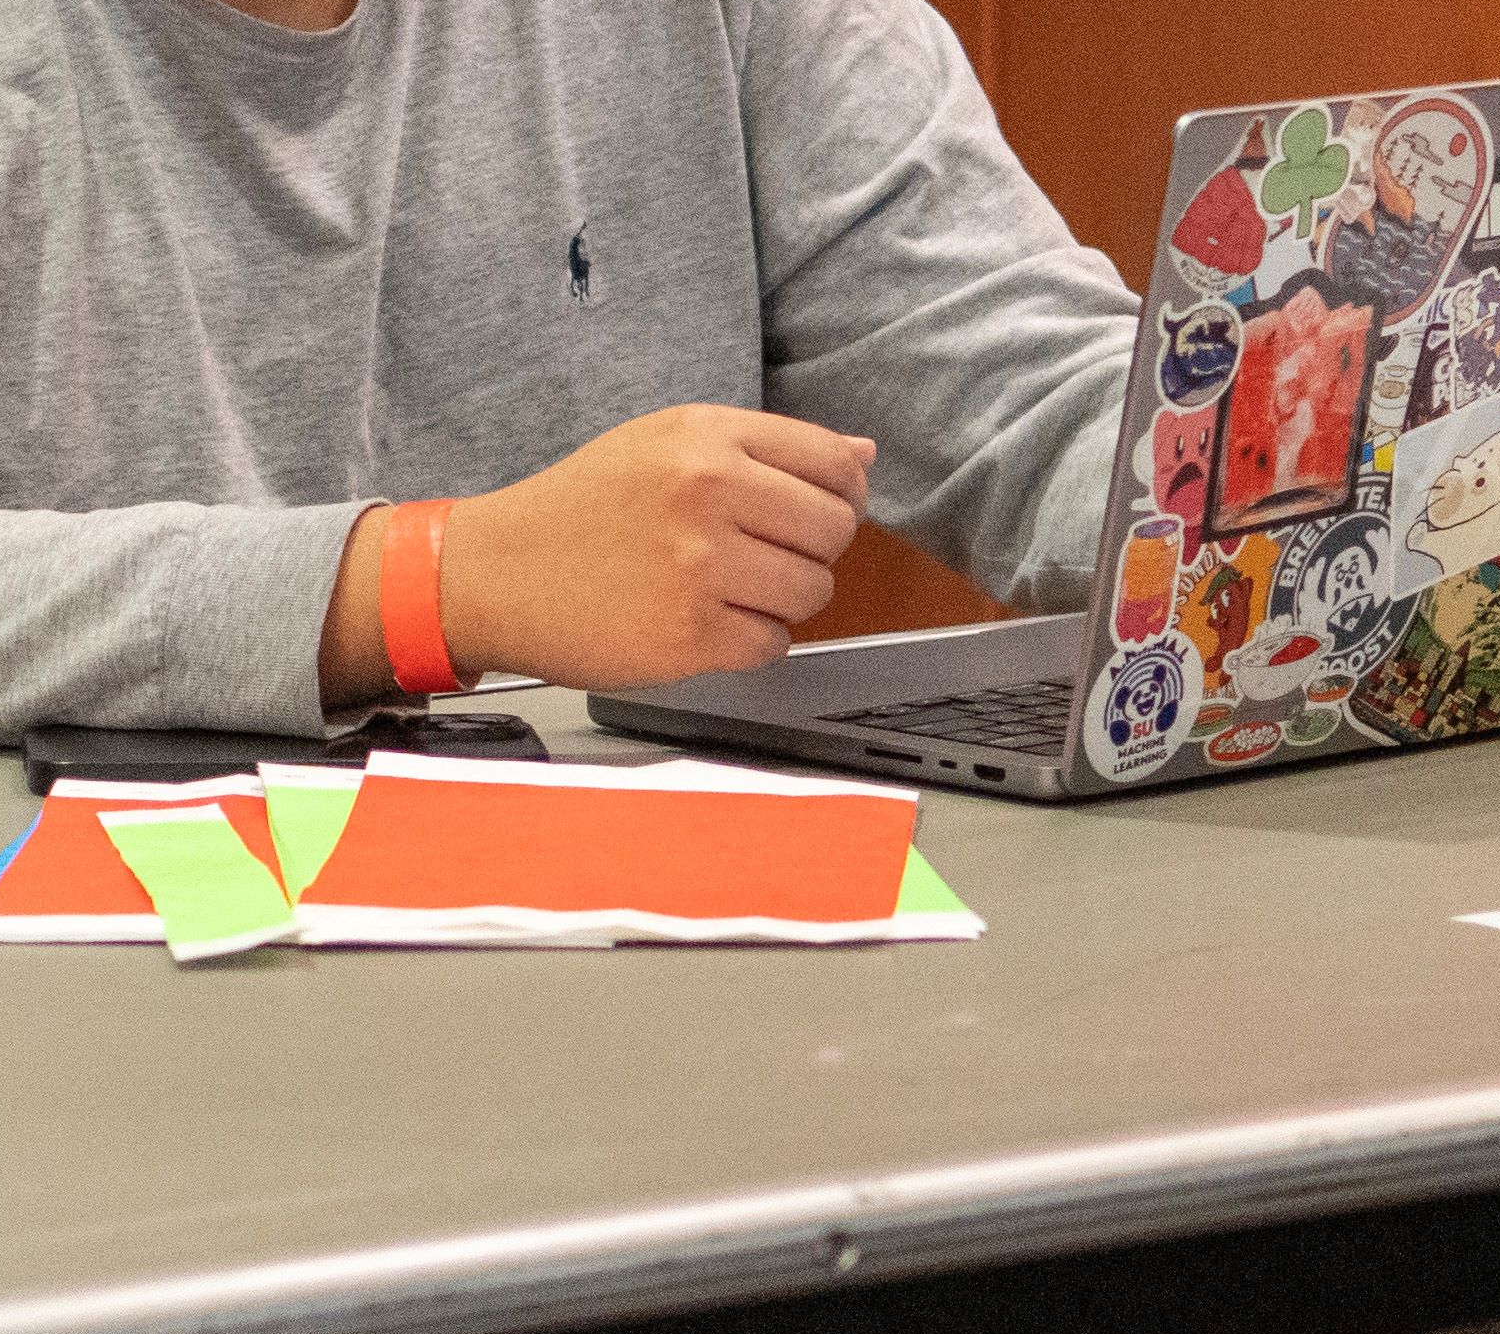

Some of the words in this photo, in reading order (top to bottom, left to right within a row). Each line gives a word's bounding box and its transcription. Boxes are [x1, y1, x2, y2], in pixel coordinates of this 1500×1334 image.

[1133, 718, 1154, 740] SU
[1117, 735, 1167, 760] MACHINE
[1113, 748, 1169, 775] LEARNING
